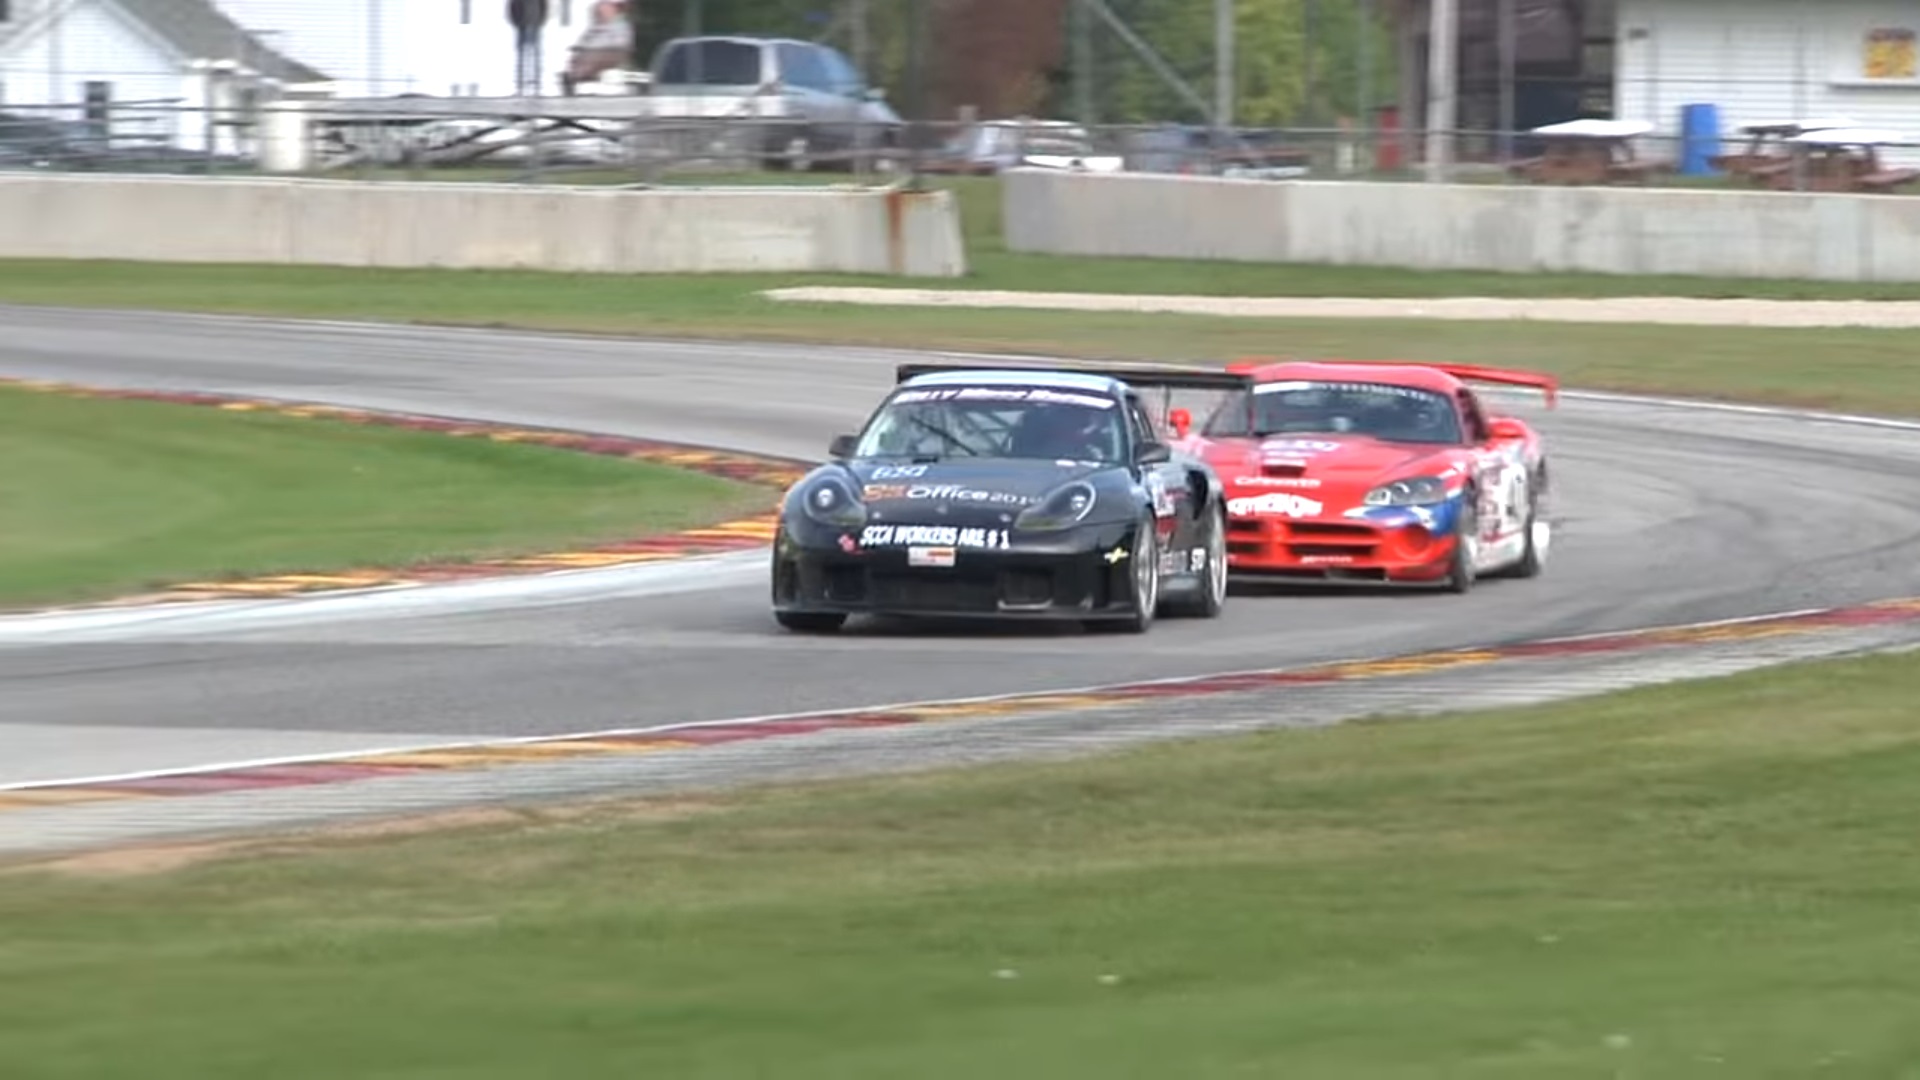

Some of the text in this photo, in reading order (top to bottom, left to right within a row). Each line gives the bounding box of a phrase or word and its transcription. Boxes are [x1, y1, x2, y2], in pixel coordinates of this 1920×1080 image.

[907, 484, 989, 501] Office
[860, 525, 894, 546] SCCA
[894, 525, 957, 546] WORKERS
[958, 528, 986, 548] ARE
[1000, 530, 1010, 550] 1
